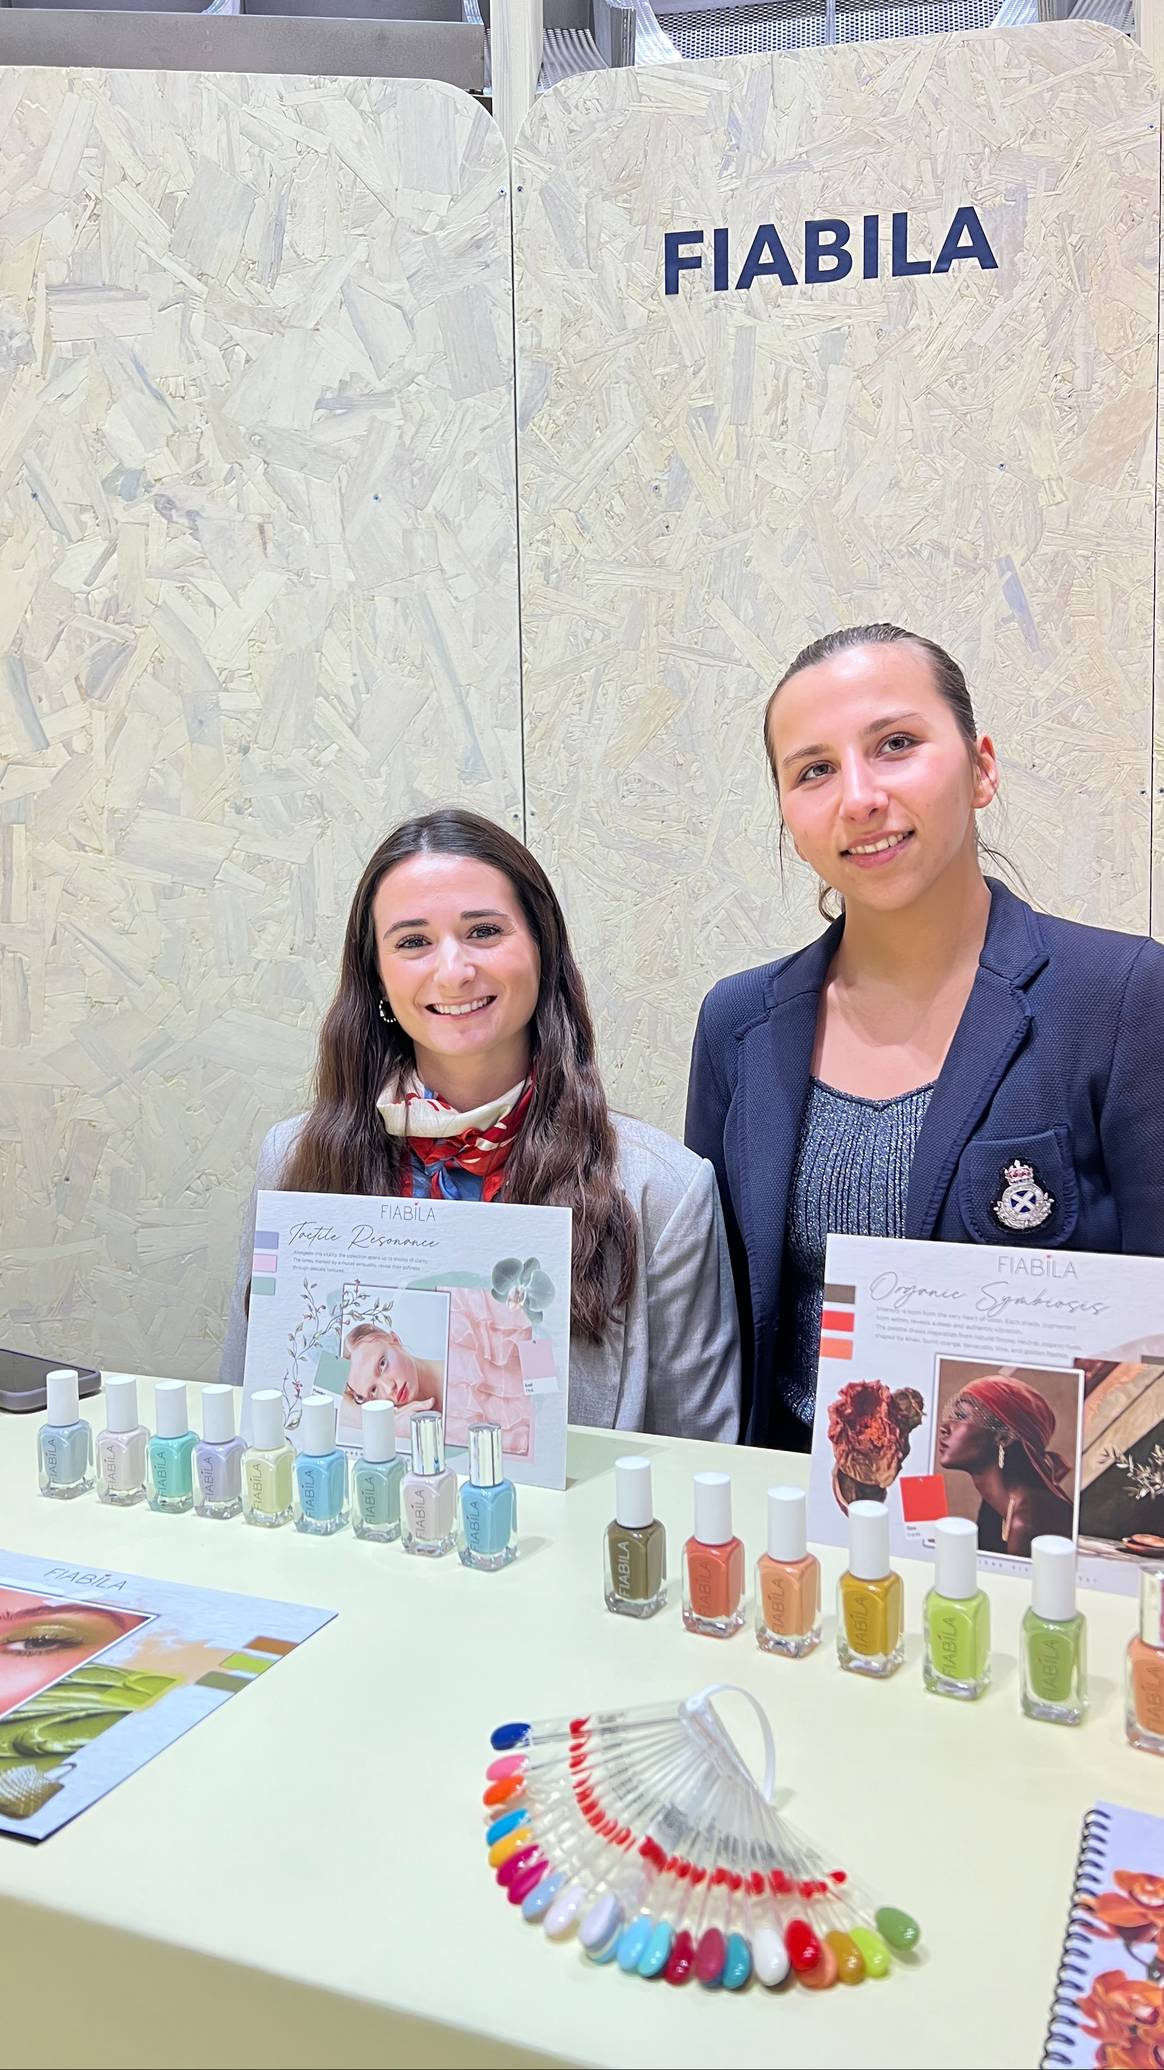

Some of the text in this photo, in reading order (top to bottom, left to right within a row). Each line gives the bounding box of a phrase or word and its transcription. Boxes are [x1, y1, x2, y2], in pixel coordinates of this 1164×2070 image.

[664, 206, 999, 295] FIABILA
[288, 1221, 440, 1250] Tactile Resonance
[380, 1202, 436, 1221] FIABILA
[870, 1271, 967, 1309] Organic
[998, 1253, 1079, 1280] FIABILA
[301, 1469, 315, 1518] FIABILA
[361, 1476, 376, 1524] FIABILA
[412, 1489, 425, 1540] FIABILA
[466, 1501, 481, 1551] FIABILA
[43, 1568, 127, 1591] FIABILA
[617, 1541, 631, 1597] FIABILA
[938, 1616, 957, 1677] FIABILA
